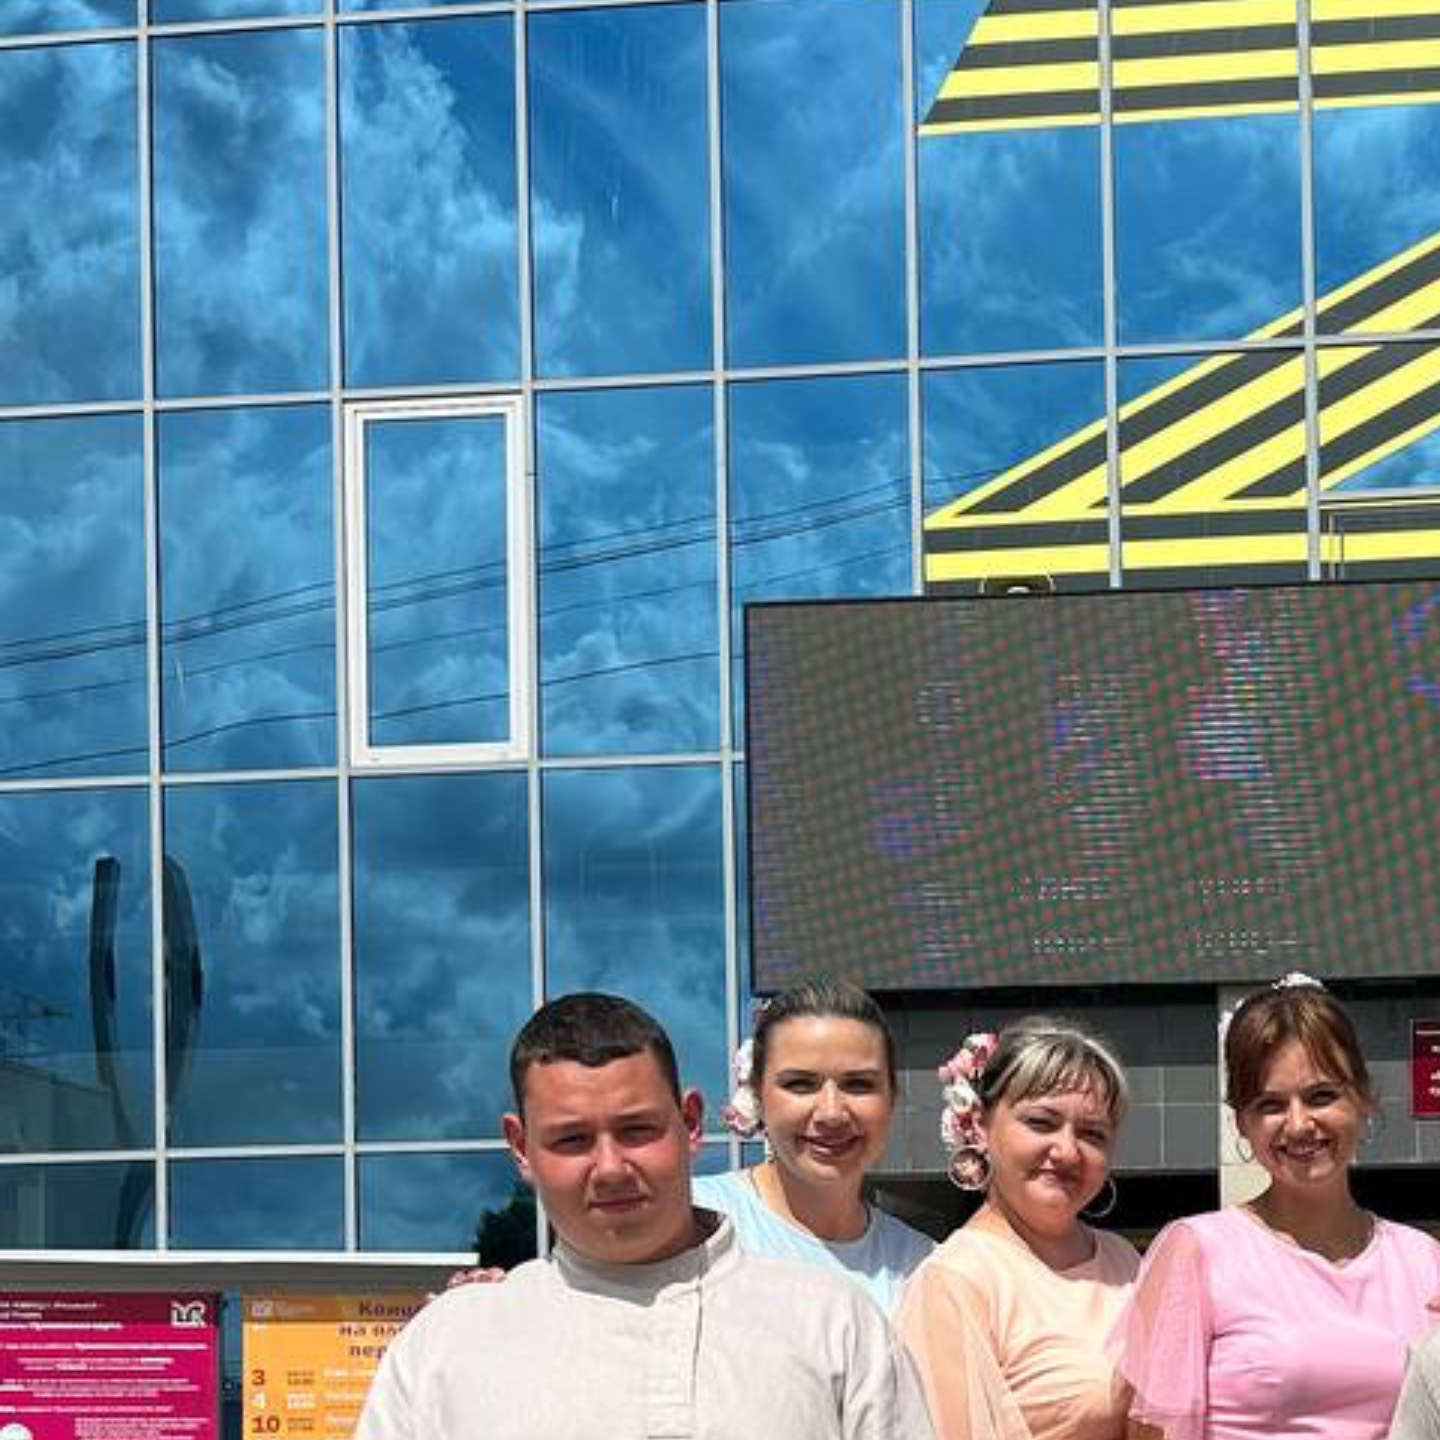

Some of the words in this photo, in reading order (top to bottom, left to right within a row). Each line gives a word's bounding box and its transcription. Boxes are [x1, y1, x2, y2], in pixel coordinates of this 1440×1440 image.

[251, 1369, 265, 1386] 3
[251, 1391, 266, 1410] 4
[251, 1415, 280, 1433] 10
